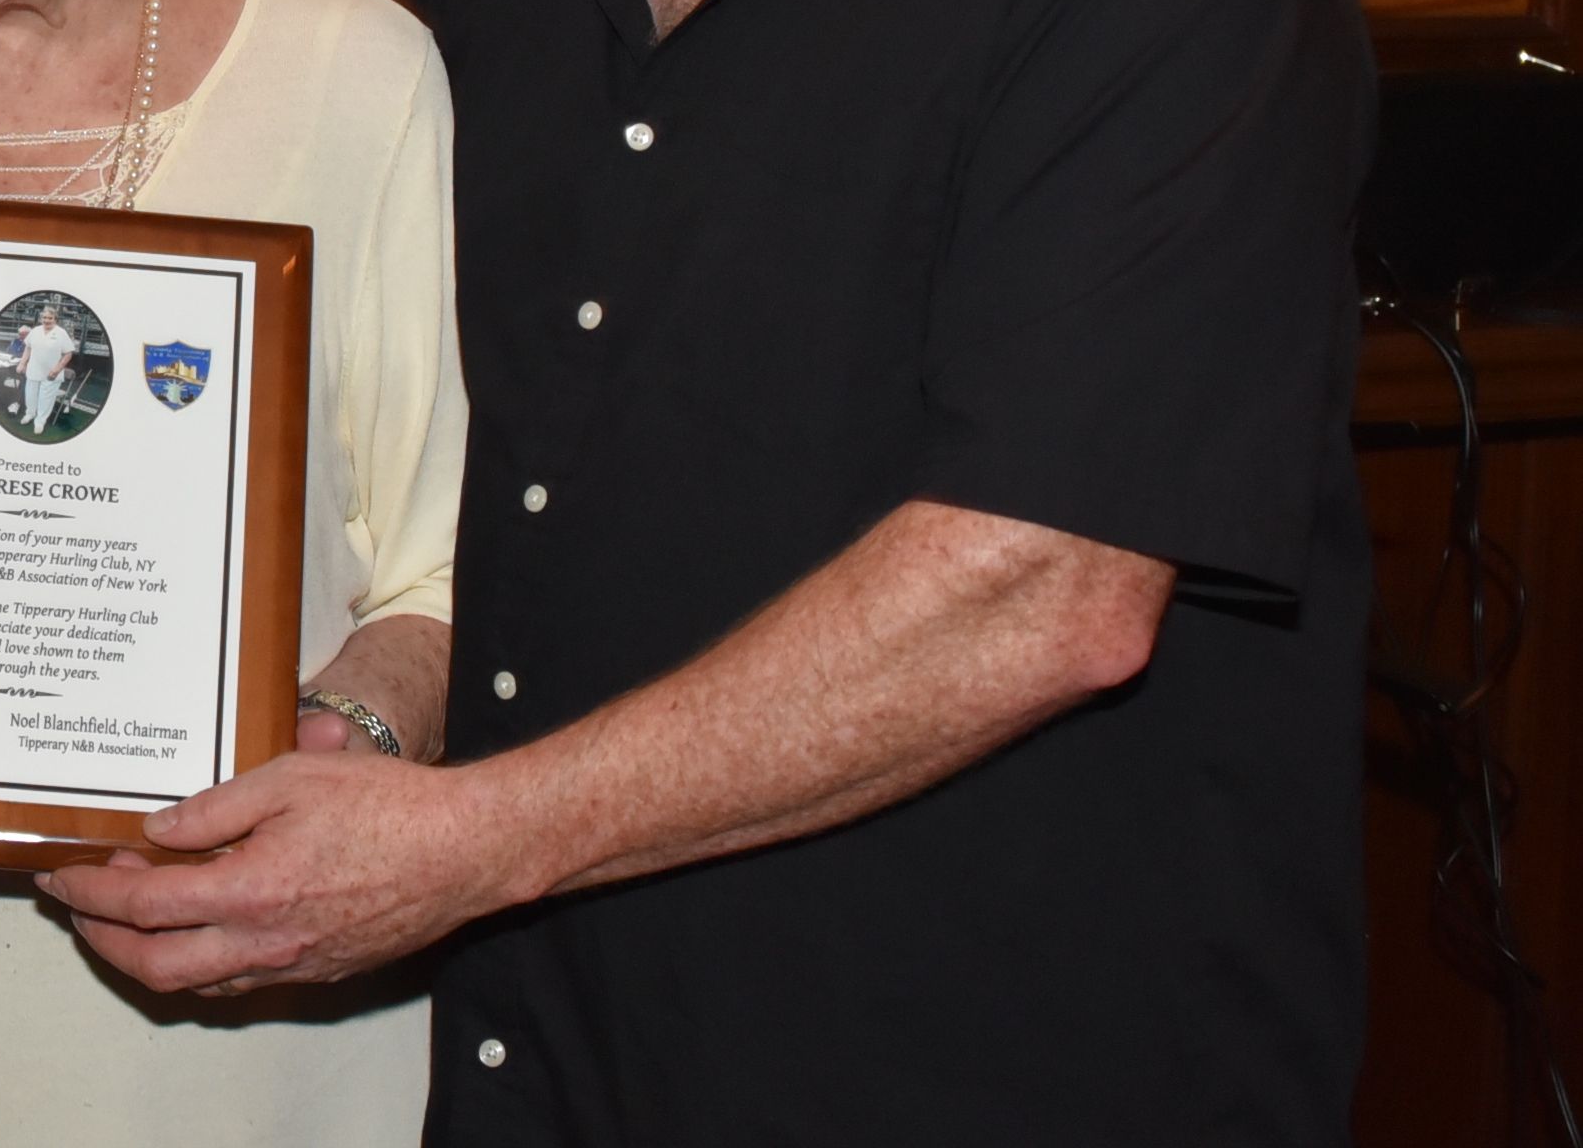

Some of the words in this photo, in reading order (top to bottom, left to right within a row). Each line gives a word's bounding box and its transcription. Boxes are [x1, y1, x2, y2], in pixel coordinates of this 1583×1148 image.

[68, 464, 81, 476] to
[49, 483, 119, 503] CROWE
[19, 530, 33, 545] of
[32, 535, 63, 547] your
[66, 537, 101, 552] many
[102, 540, 137, 553] years
[50, 553, 97, 572] Hurling
[101, 555, 132, 572] Club,
[136, 560, 156, 572] NY
[17, 570, 88, 587] Association
[91, 574, 107, 590] of
[107, 577, 134, 590] New
[139, 579, 167, 593] York
[14, 602, 75, 622] Tipperary
[78, 607, 126, 626] Hurling
[130, 610, 158, 625] Club
[33, 626, 64, 639] your
[67, 625, 136, 644] dedication,
[5, 639, 30, 654] love
[33, 642, 73, 658] shown
[77, 648, 89, 659] to
[93, 647, 124, 662] them
[40, 662, 60, 677] the
[61, 668, 99, 681] years.
[10, 712, 40, 729] Noel
[44, 714, 120, 737] Blanchfield,
[124, 720, 187, 740] Chairman
[19, 736, 69, 754] Tipperary
[72, 740, 94, 752] N&B
[97, 742, 158, 759] Association,
[161, 747, 177, 759] NY
